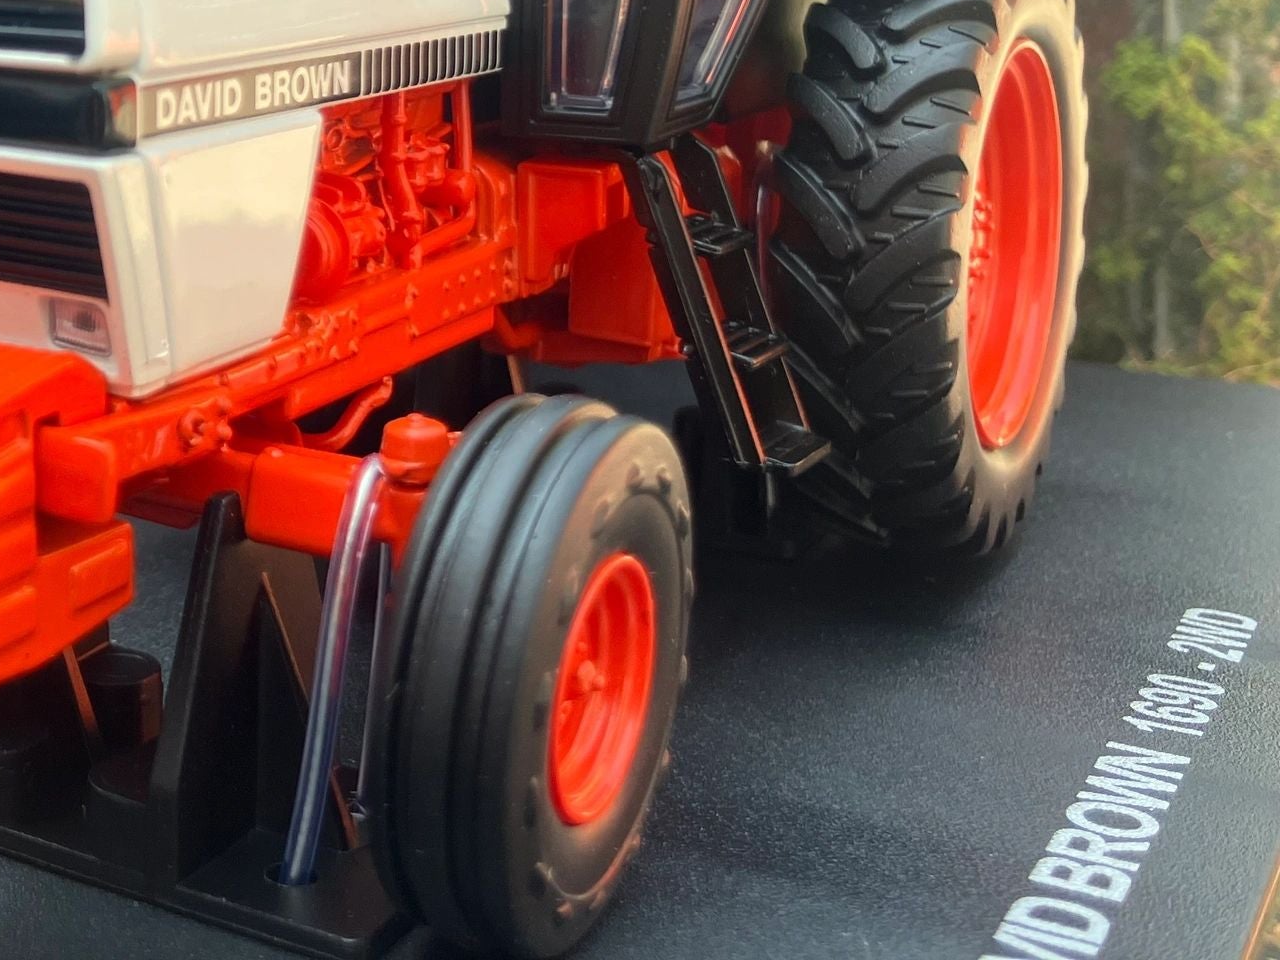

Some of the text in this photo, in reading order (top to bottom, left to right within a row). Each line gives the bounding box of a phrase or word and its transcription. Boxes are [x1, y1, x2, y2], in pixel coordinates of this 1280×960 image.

[155, 59, 352, 130] DAVID BROWN
[1166, 607, 1258, 662] 2WD
[1122, 673, 1225, 736] 1690
[1028, 740, 1191, 903] BROWN
